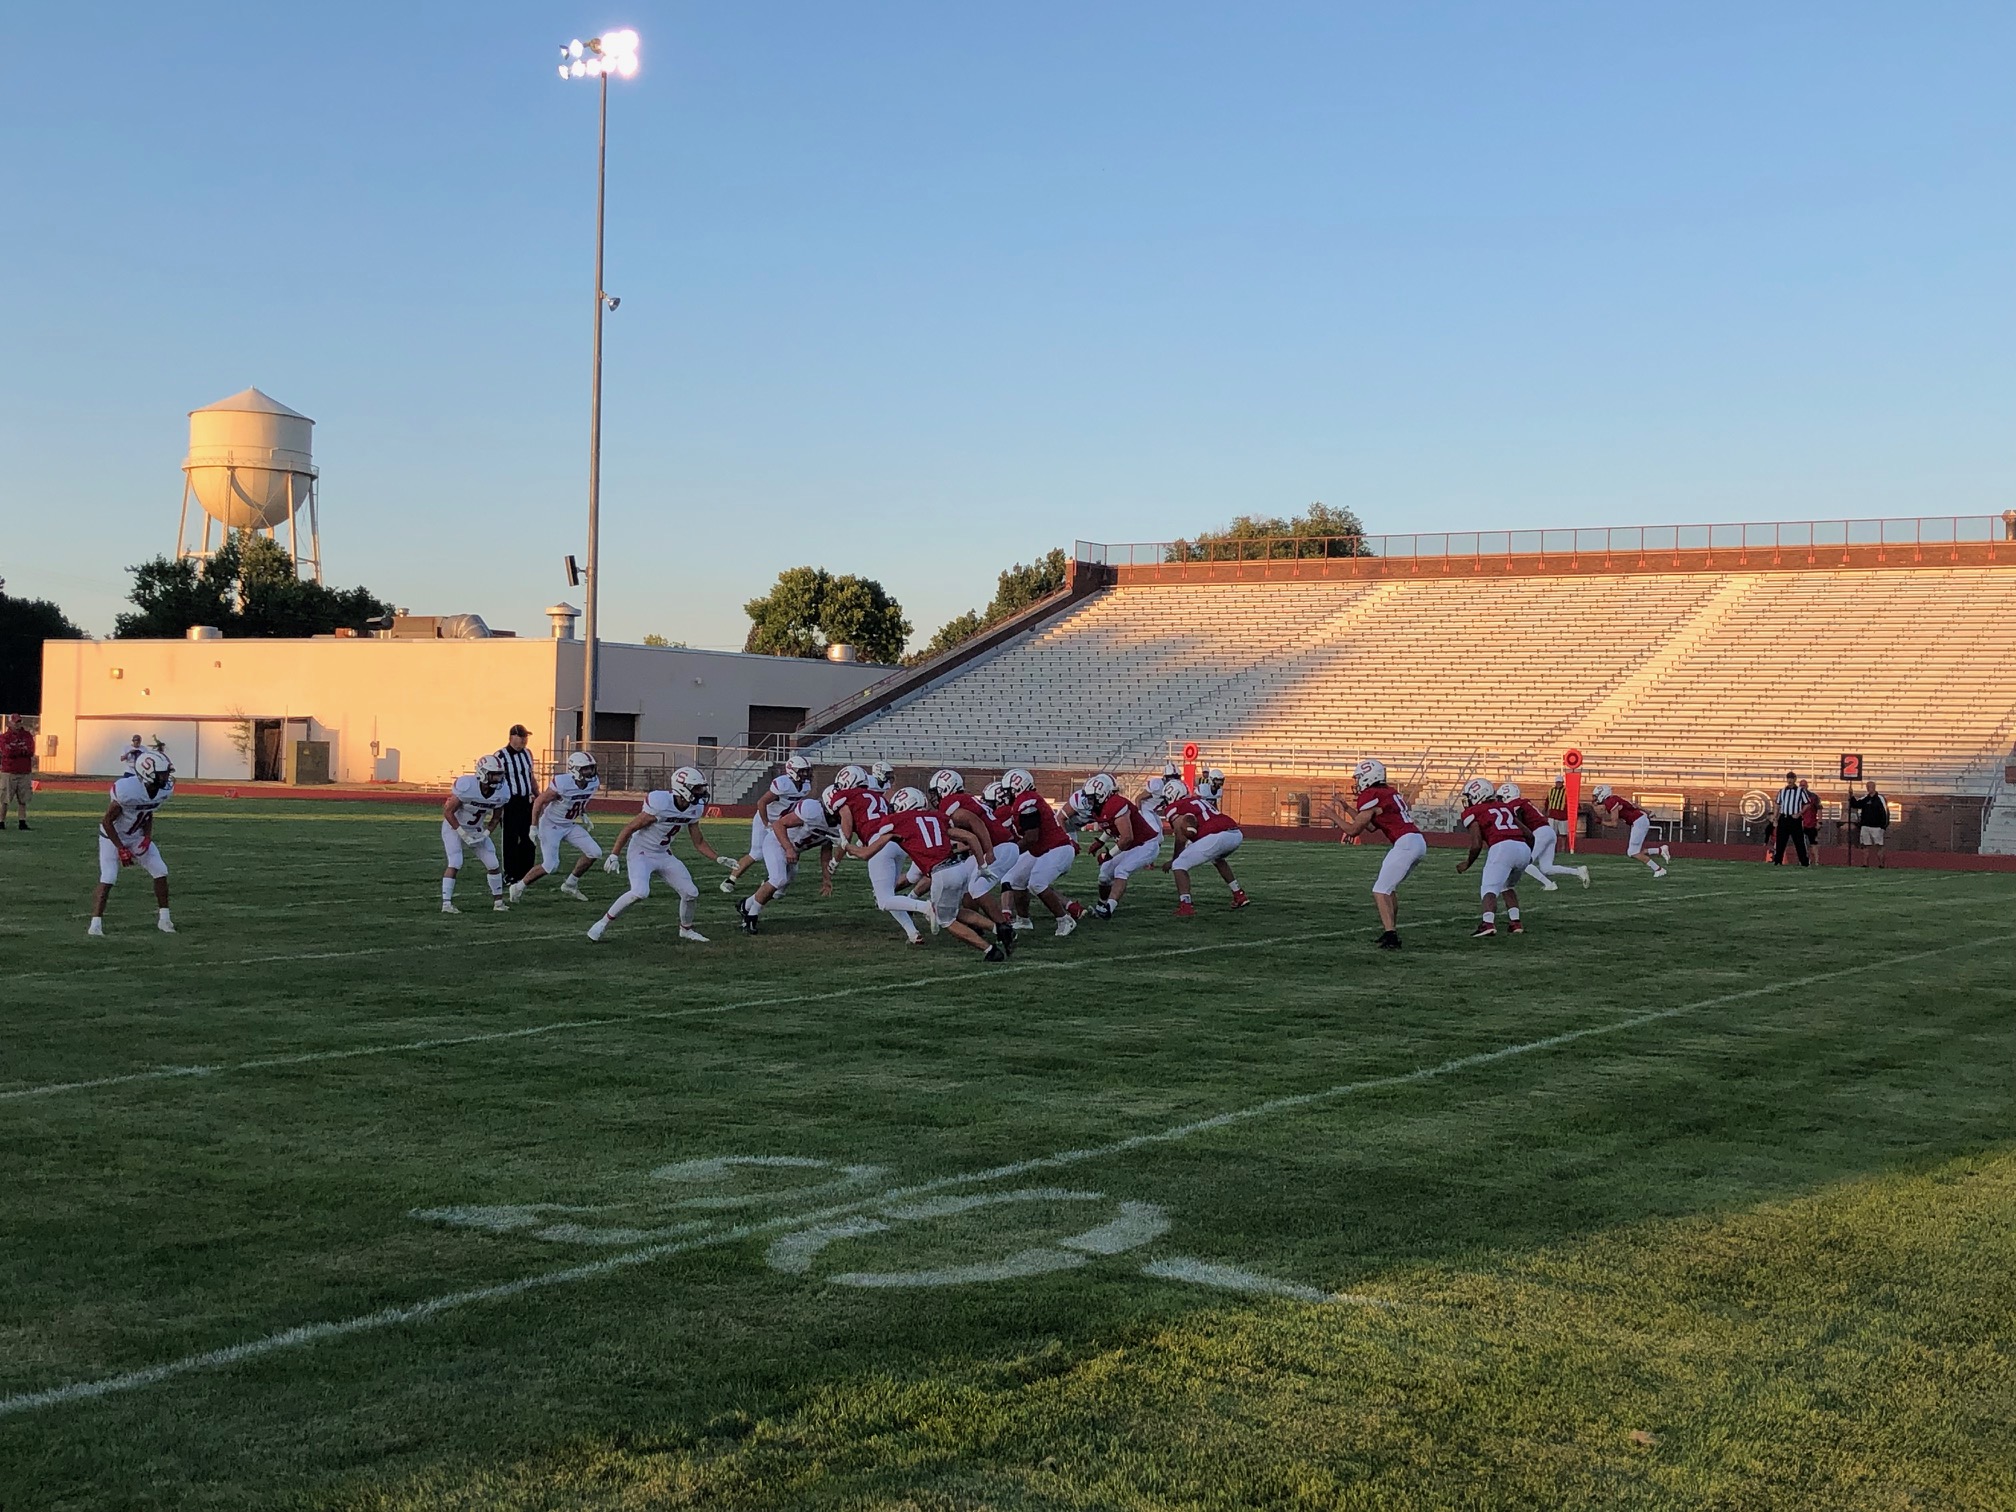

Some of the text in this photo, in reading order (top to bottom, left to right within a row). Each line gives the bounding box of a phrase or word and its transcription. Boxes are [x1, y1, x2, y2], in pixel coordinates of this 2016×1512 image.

[141, 756, 155, 771] S
[1360, 762, 1373, 774] S
[1843, 755, 1859, 774] 2
[676, 771, 688, 785] S
[838, 770, 852, 782] S
[938, 770, 952, 782] S
[1011, 772, 1023, 787] S
[1091, 780, 1104, 792] S
[1163, 784, 1175, 798] S
[1471, 780, 1482, 794] S
[897, 789, 909, 803] S
[862, 792, 889, 820] 24
[466, 809, 487, 826] 5
[1487, 806, 1519, 831] 22
[914, 815, 944, 848] 17
